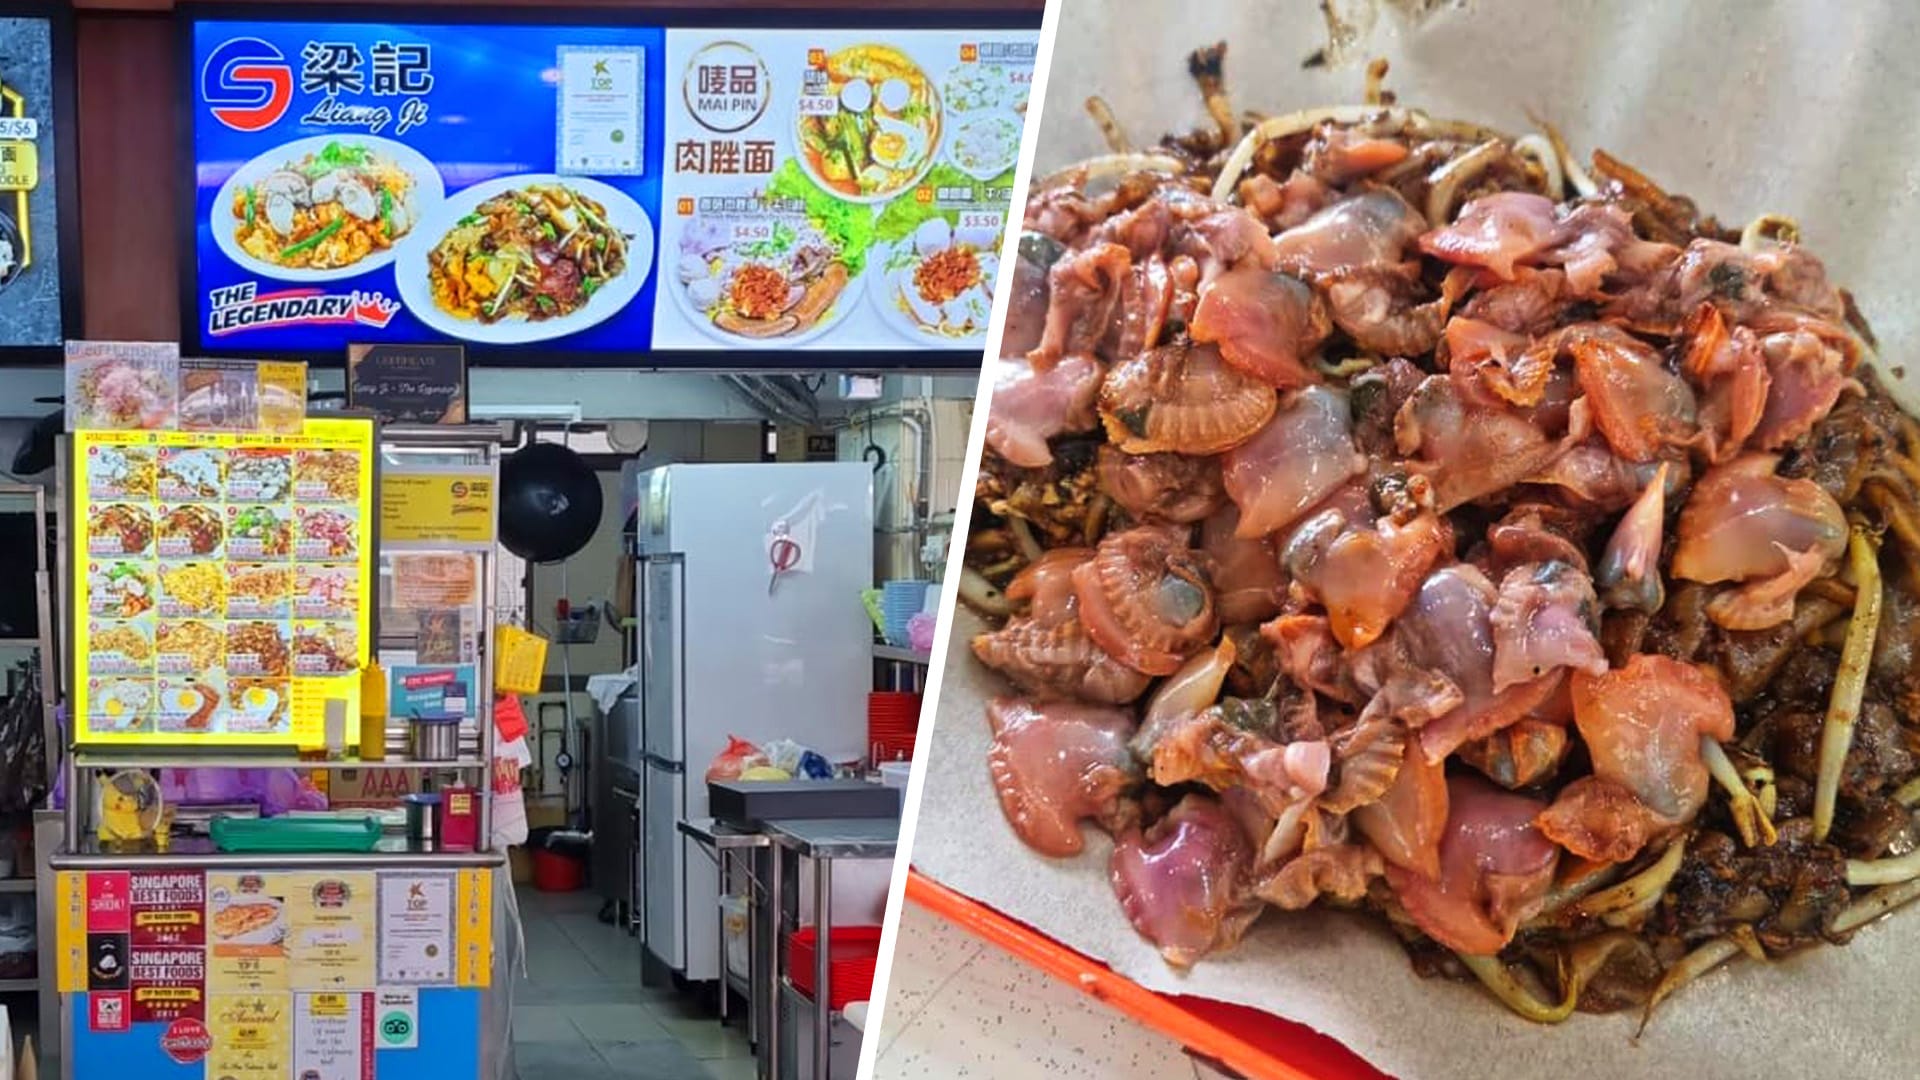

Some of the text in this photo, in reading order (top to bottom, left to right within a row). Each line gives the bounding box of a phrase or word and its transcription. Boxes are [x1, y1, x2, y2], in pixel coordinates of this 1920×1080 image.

[301, 40, 432, 96] 梁記
[698, 98, 757, 112] MAI PIN
[799, 99, 833, 111] $4.50
[304, 98, 428, 134] Liang Ji
[965, 215, 999, 227] $3.50
[735, 226, 769, 238] $4.50
[211, 283, 255, 306] THE
[209, 297, 355, 331] LEGENDARY
[131, 875, 200, 889] SINGAPORE
[133, 889, 200, 902] BEST FOODS
[132, 952, 203, 965] SINGAPORE
[133, 966, 200, 977] BEST FOODS
